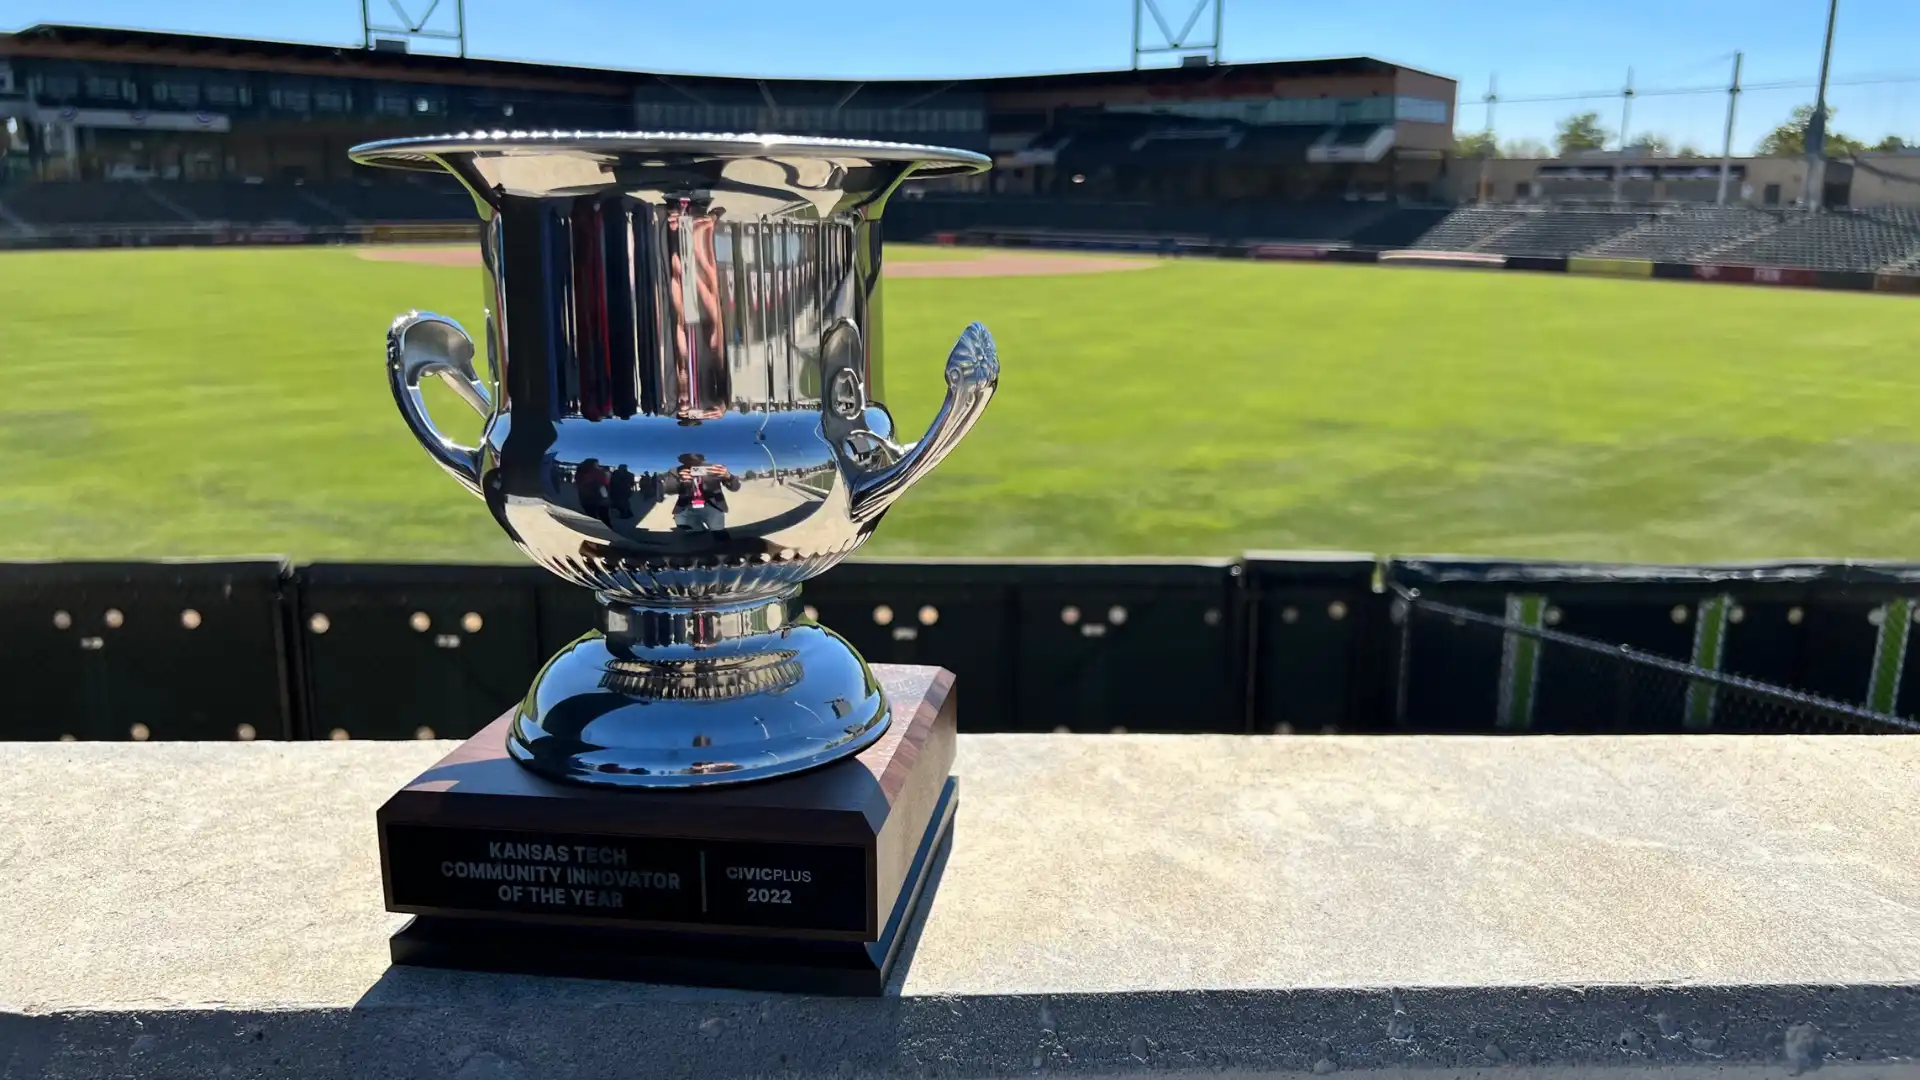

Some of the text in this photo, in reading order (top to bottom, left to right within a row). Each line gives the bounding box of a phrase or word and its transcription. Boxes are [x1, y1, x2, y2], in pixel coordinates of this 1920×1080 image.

[489, 841, 628, 866] KANSAS TECH
[440, 860, 681, 890] COMMUNITY INNOVATOR
[725, 867, 812, 883] CIVICPLUS
[498, 885, 624, 908] OF THE YEAR
[747, 888, 792, 904] 2022
